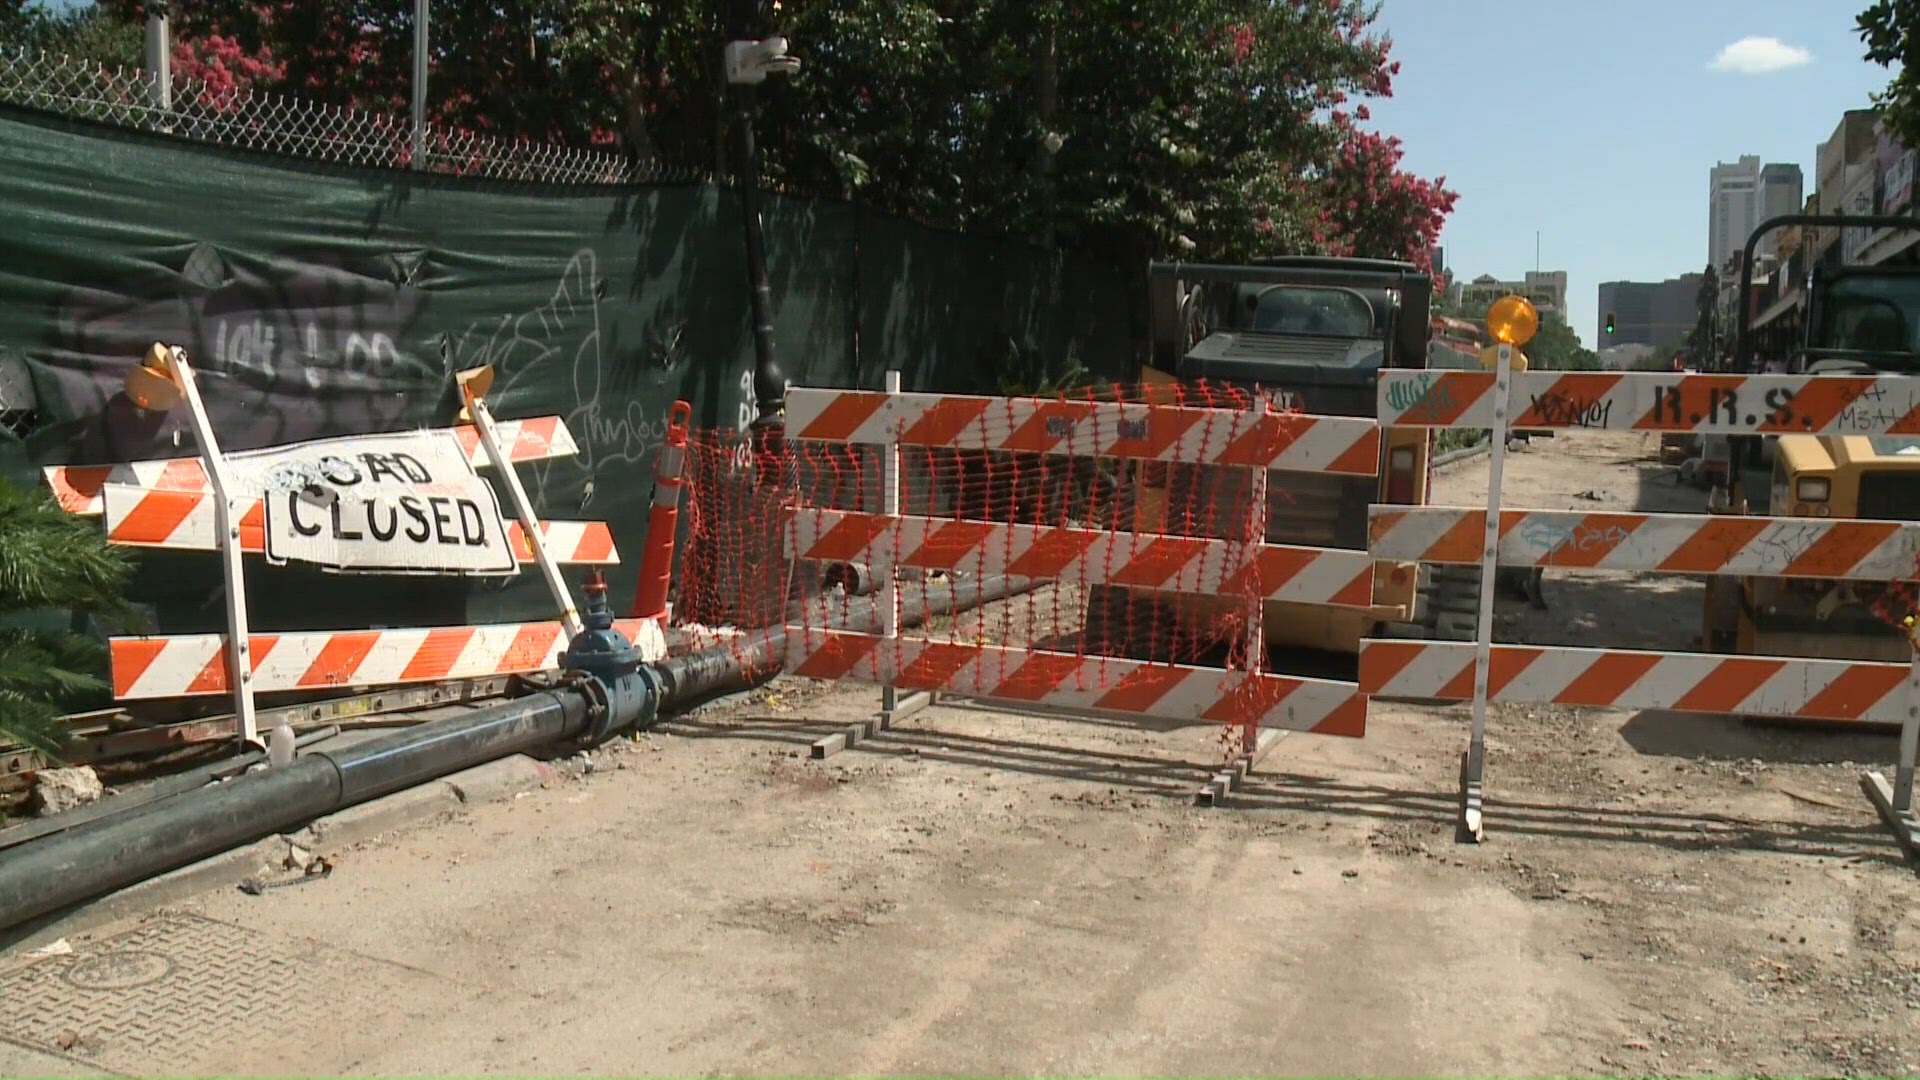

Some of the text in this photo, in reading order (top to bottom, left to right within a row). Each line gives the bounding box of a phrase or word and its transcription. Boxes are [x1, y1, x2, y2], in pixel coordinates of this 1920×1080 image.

[1653, 384, 1814, 427] R.R.S.
[274, 452, 433, 489] OAD
[288, 482, 487, 547] CLOSED
